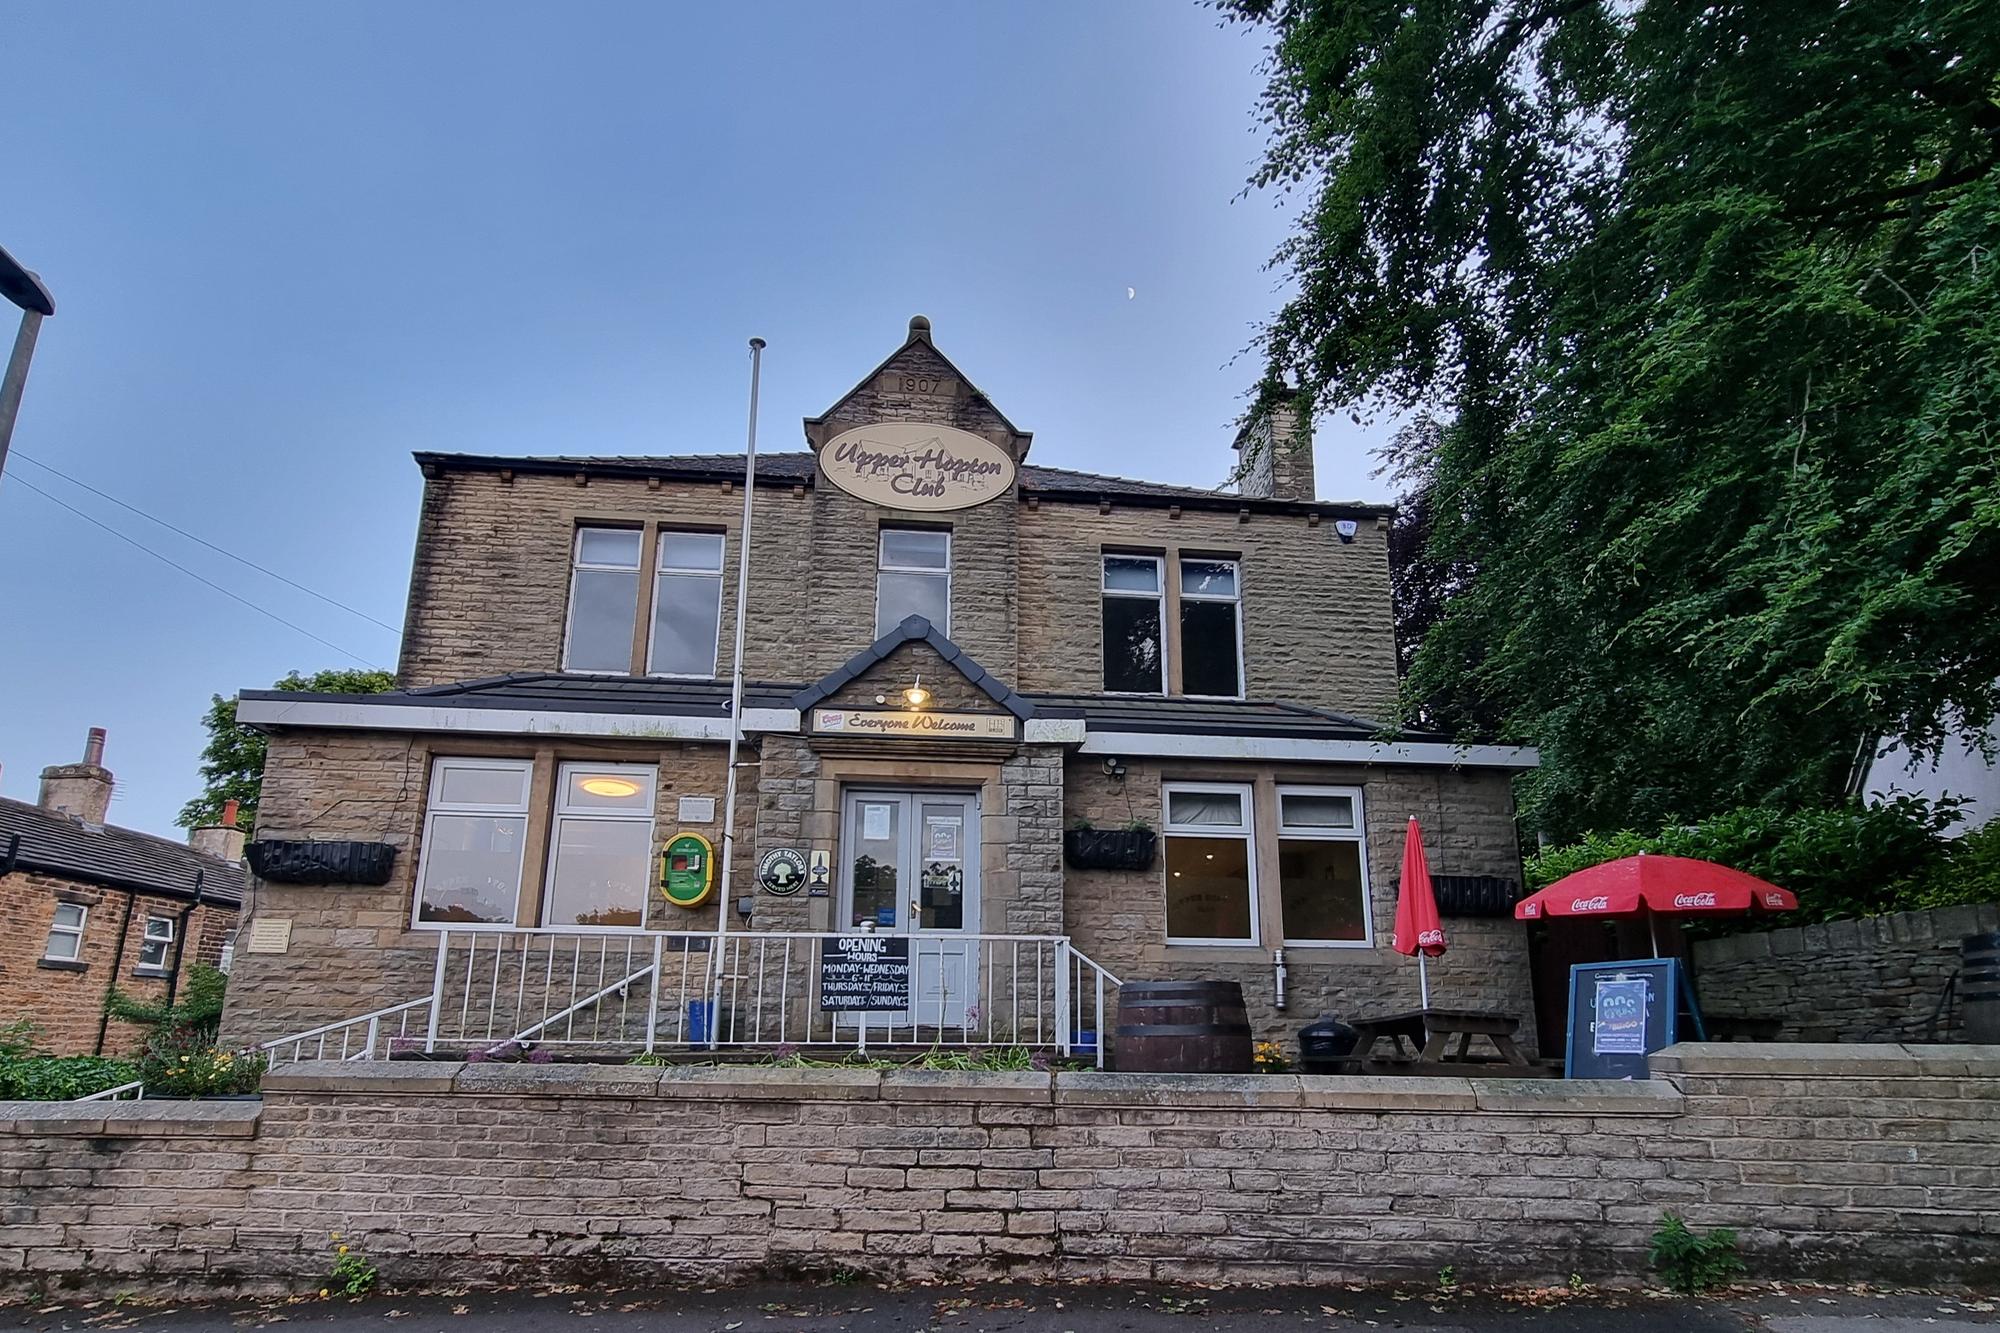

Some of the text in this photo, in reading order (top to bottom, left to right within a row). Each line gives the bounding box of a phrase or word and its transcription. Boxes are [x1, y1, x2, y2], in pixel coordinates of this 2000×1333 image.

[835, 442, 1001, 481] Upper Hopton
[890, 473, 946, 498] Club
[849, 713, 909, 732] Everyone
[912, 715, 976, 731] Welcome
[761, 851, 782, 875] TIMOTHY
[838, 938, 887, 953] OPENING
[847, 952, 878, 962] HOURS
